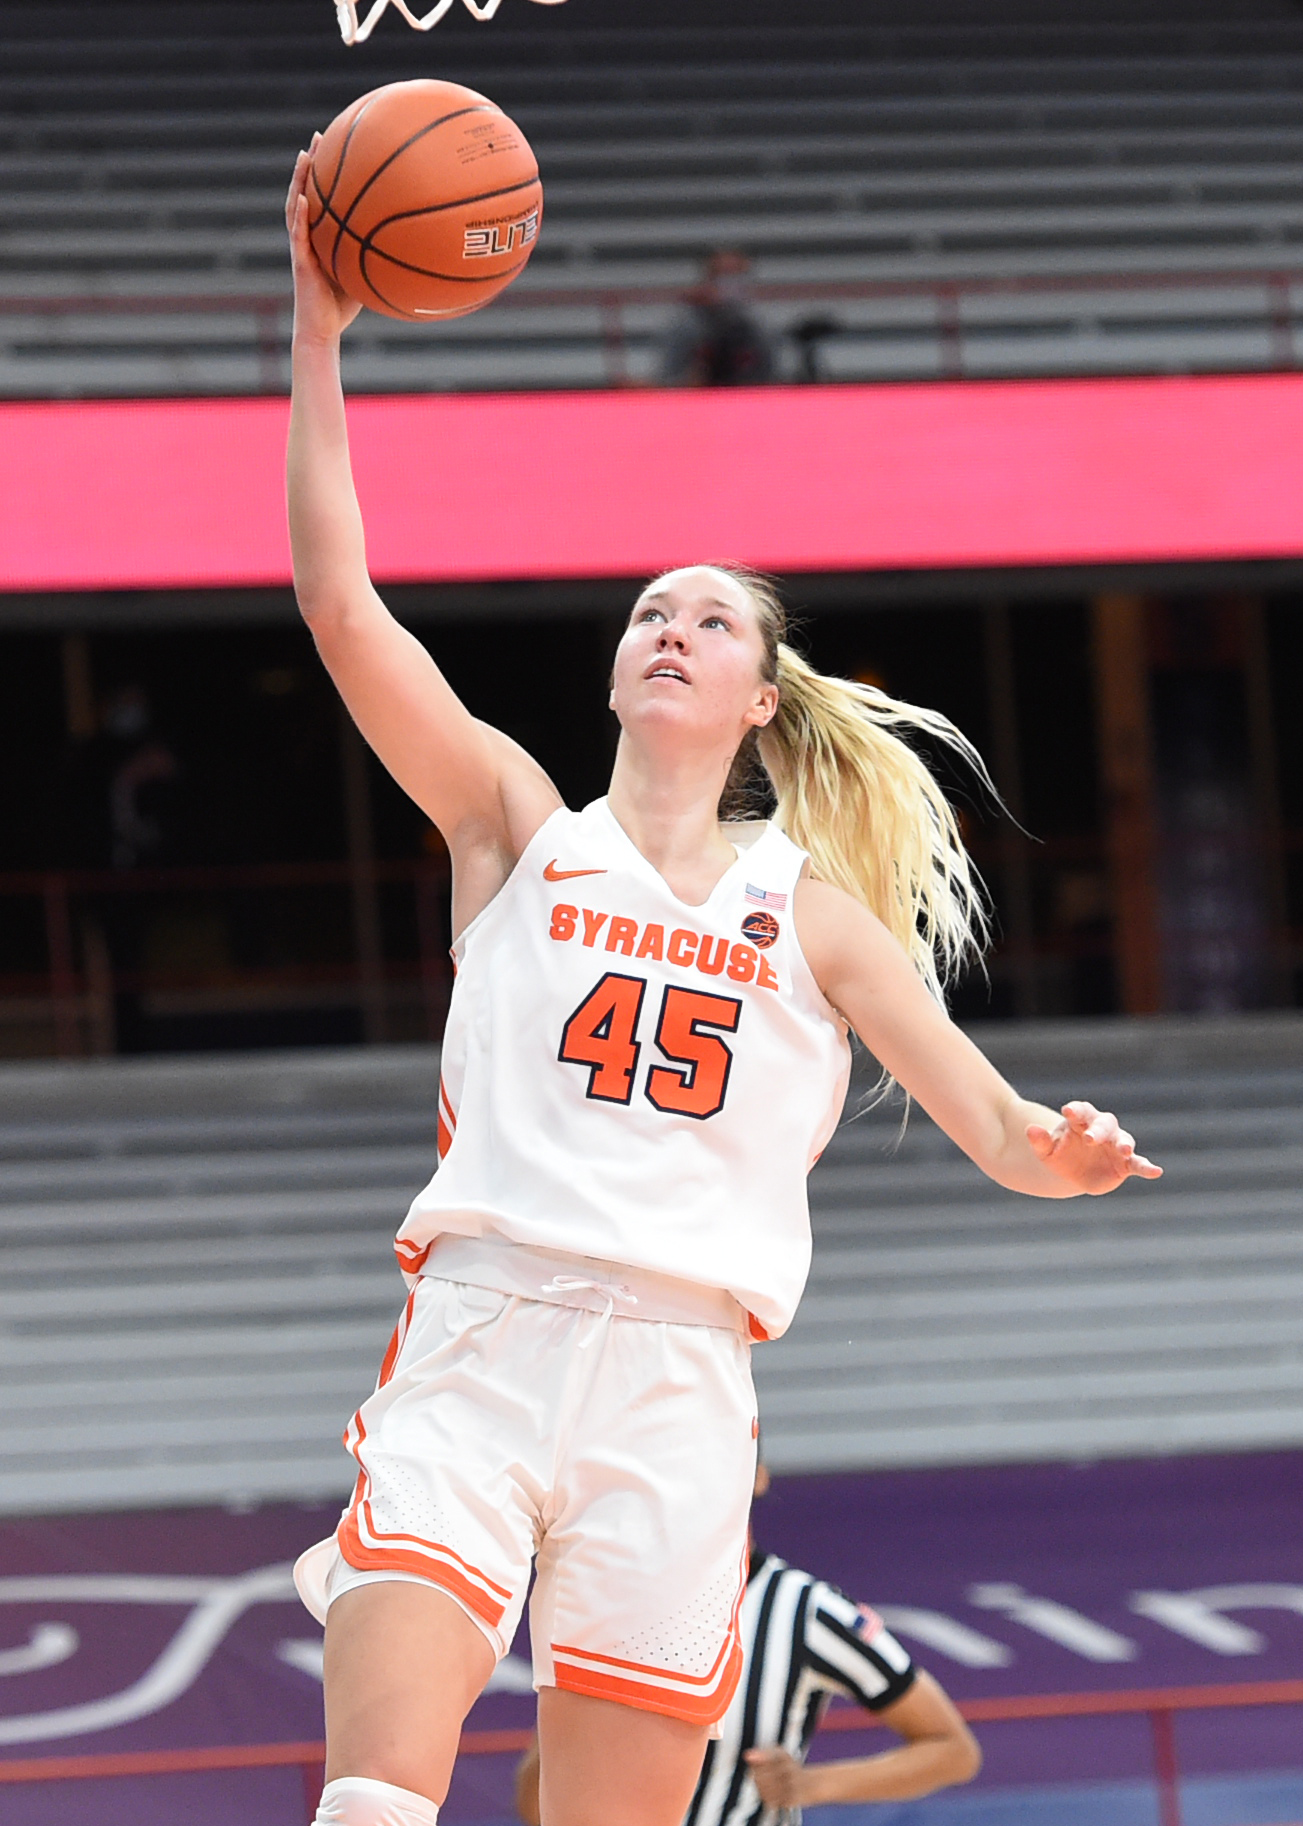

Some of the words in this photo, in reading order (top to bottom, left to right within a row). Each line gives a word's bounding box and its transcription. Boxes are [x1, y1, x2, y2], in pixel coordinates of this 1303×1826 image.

[462, 210, 539, 259] ELITE
[549, 903, 779, 992] SYRACUSE
[745, 921, 778, 934] ACC
[557, 971, 743, 1120] 45
